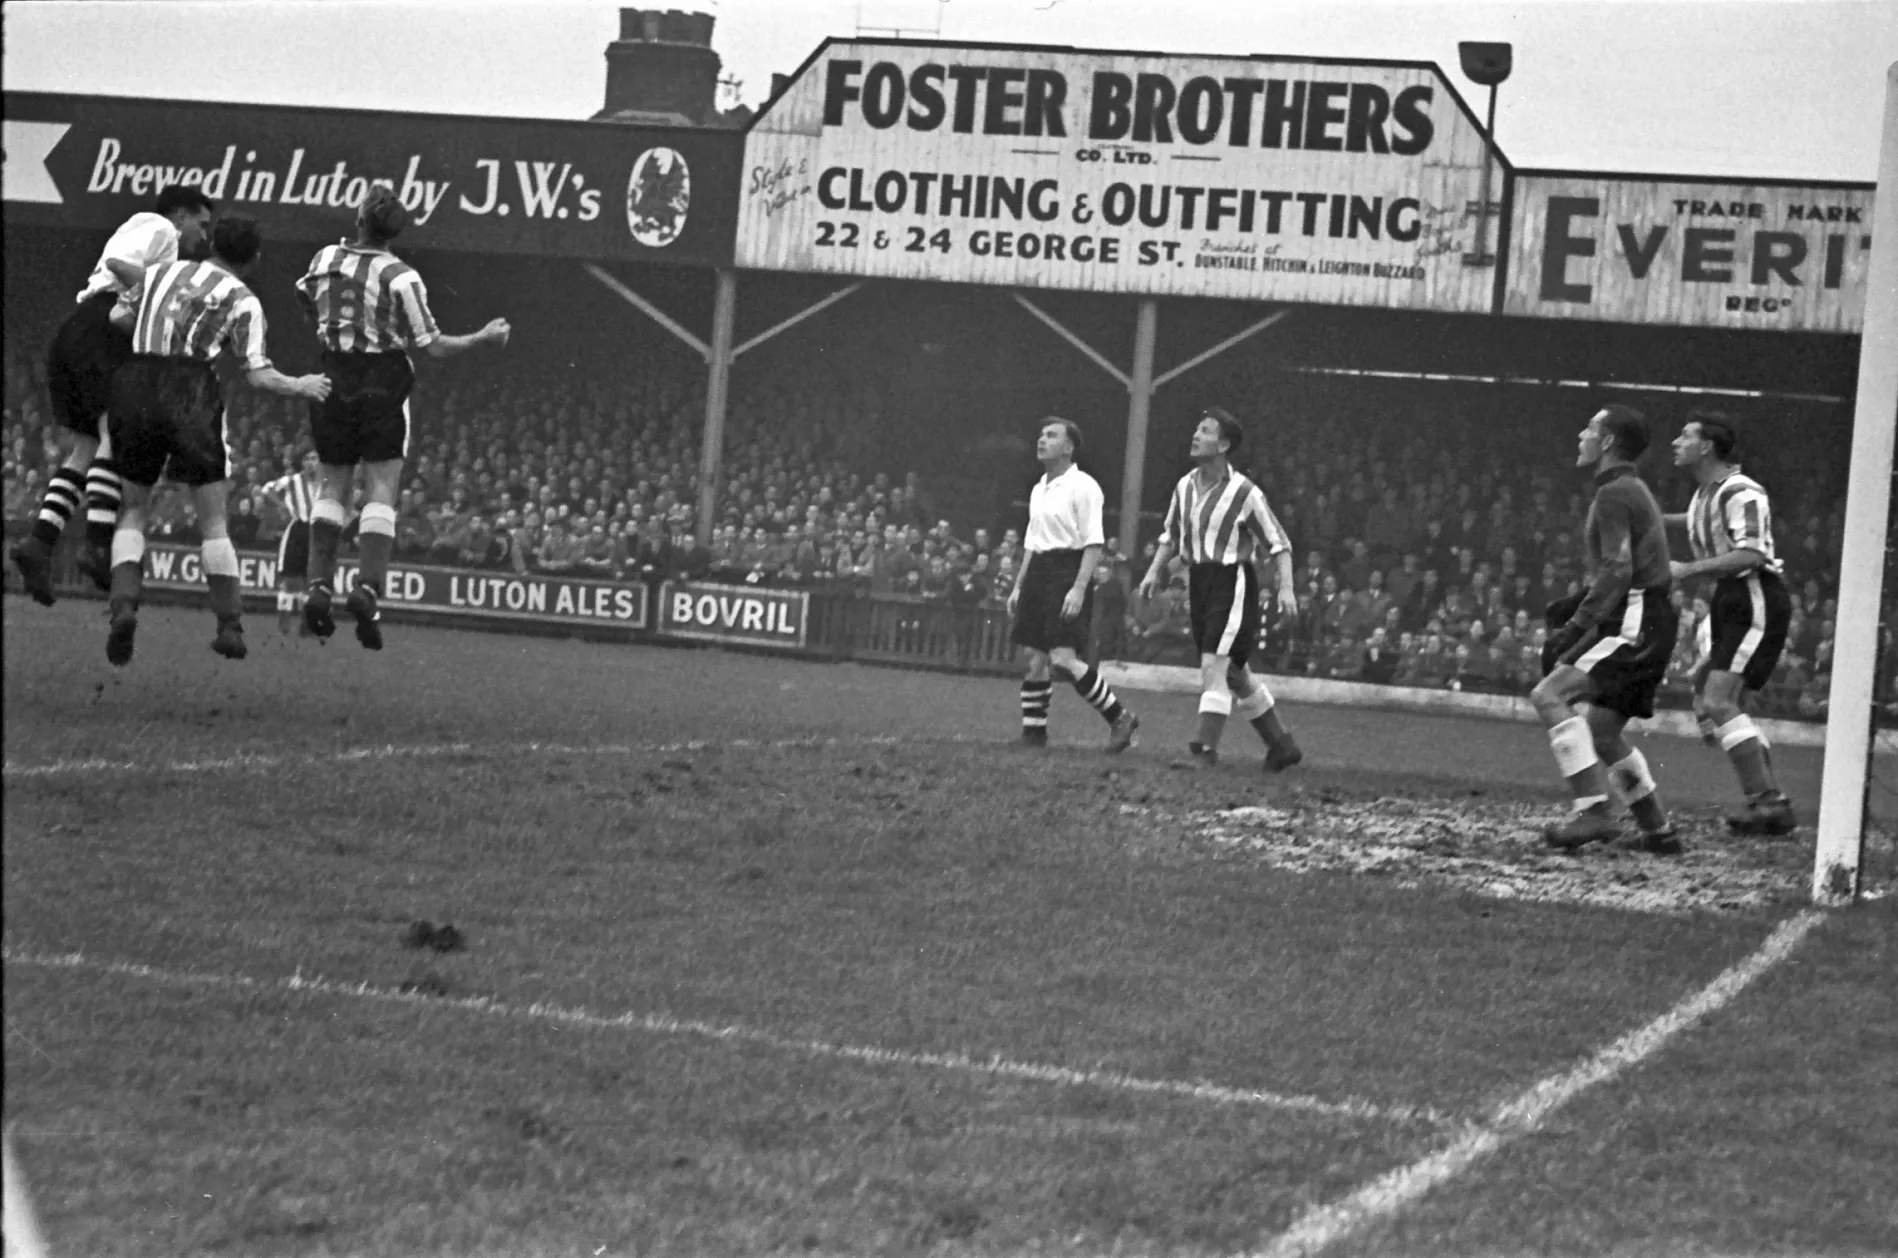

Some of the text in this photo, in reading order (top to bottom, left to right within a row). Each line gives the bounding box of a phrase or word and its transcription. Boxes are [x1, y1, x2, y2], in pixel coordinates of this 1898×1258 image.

[823, 59, 1435, 155] FOSTER BROTHERS
[1076, 148, 1158, 165] CO. LTD.
[87, 137, 237, 199] Brewed
[235, 150, 276, 201] in
[400, 155, 451, 226] by
[817, 167, 1060, 222] CLOTHING
[1071, 193, 1094, 224] &
[1101, 181, 1422, 242] OUTFITTING
[1673, 199, 1862, 223] TRADE MARK
[814, 220, 1184, 268] 22 & 24 GEORGE ST.
[1539, 195, 1872, 304] EVERI
[450, 576, 547, 611] LUTON
[555, 584, 634, 619] ALES
[672, 591, 796, 634] BOVRIL
